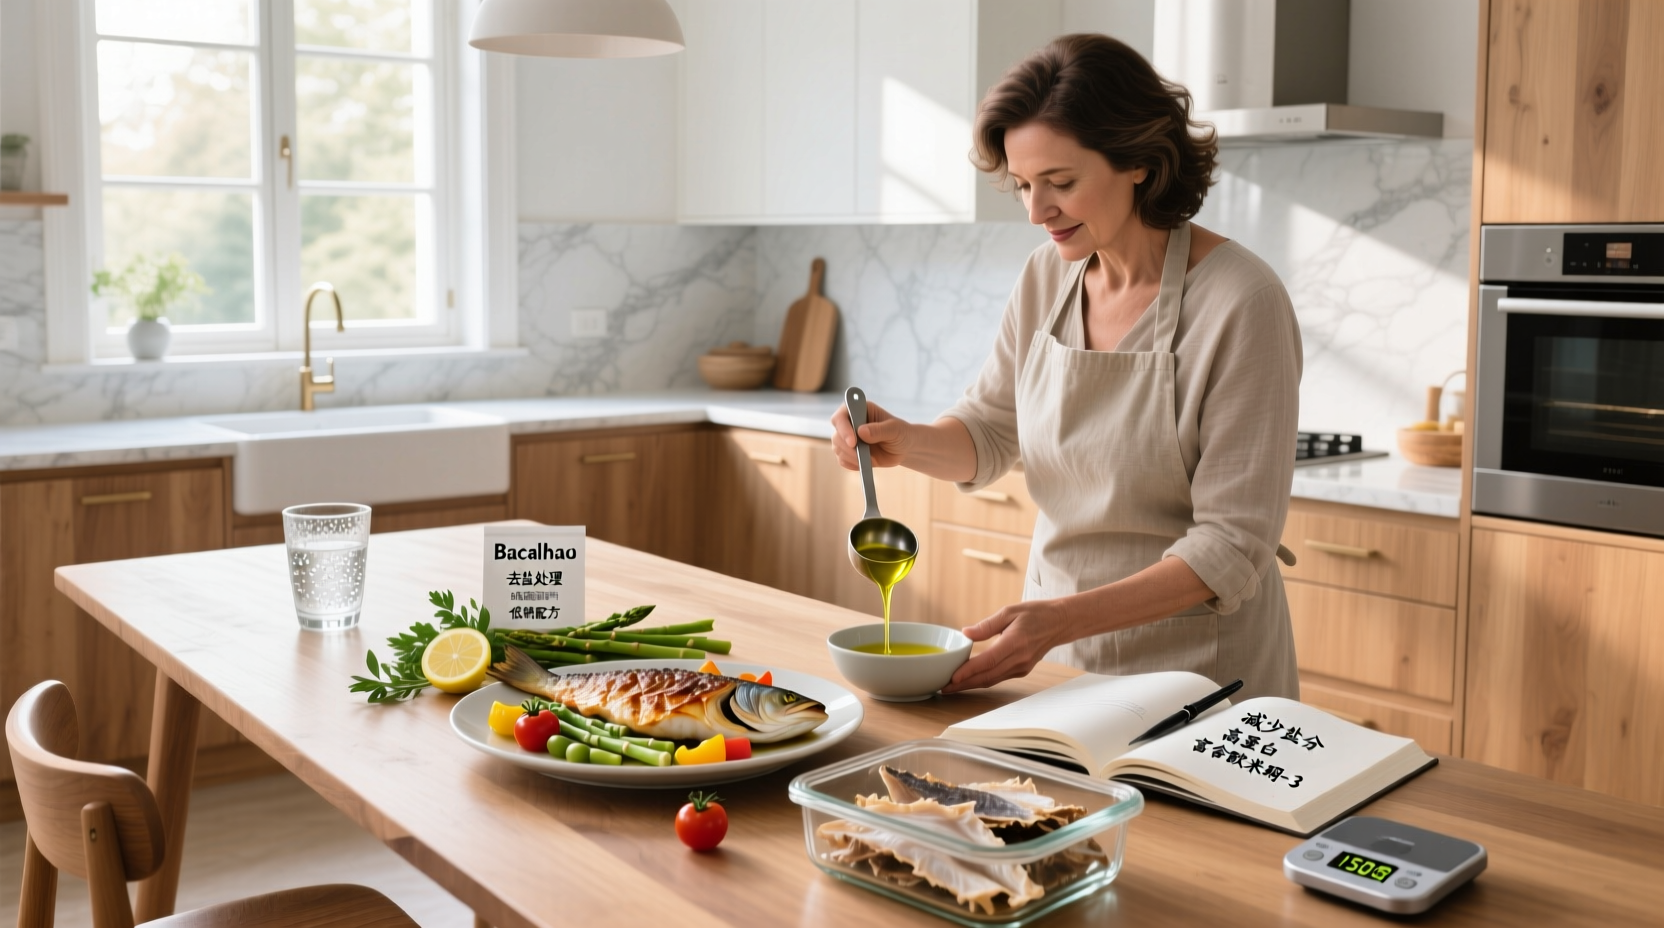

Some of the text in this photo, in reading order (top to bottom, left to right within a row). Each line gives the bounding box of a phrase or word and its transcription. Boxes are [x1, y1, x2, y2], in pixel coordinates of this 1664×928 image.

[494, 542, 577, 560] Bacalhao
[1241, 712, 1325, 751] 减少盐分
